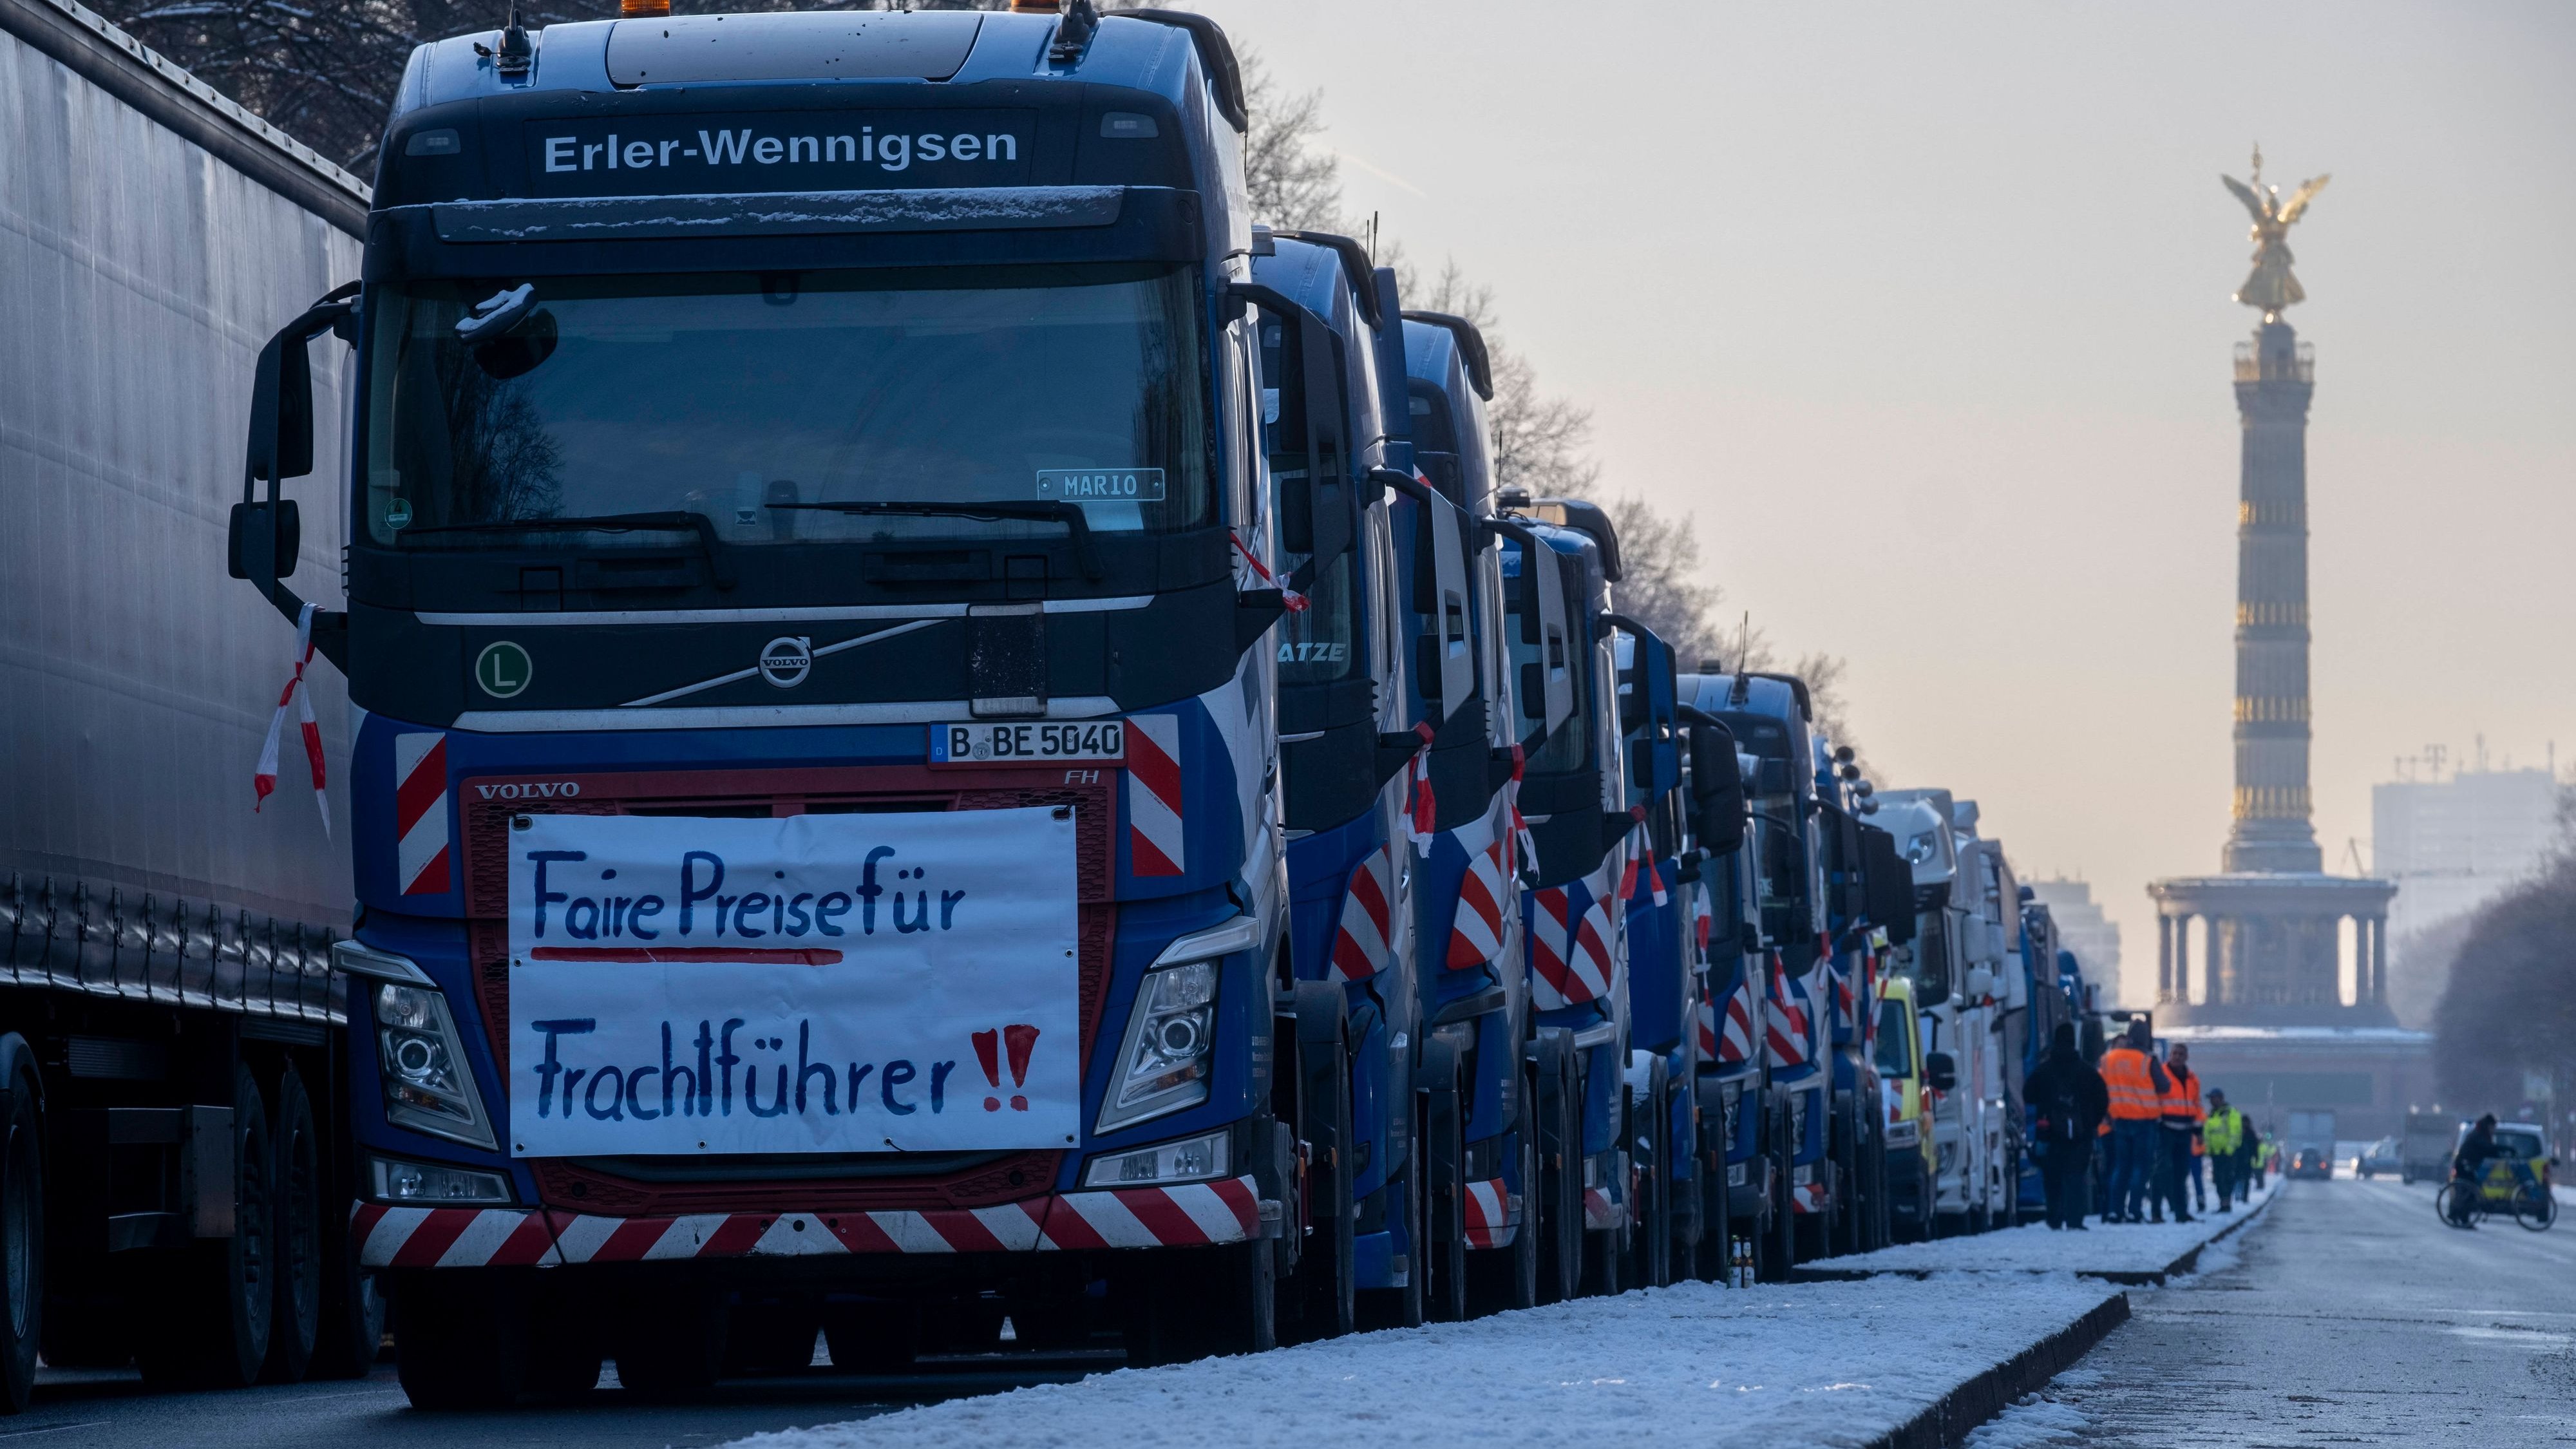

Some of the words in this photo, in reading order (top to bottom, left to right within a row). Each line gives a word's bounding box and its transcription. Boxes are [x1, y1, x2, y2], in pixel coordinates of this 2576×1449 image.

[545, 126, 1017, 171] Erler-Wennigsen
[1065, 475, 1137, 496] MARIO
[494, 654, 516, 687] L
[762, 658, 808, 667] VOLVO
[936, 747, 943, 755] D
[951, 728, 971, 757] B
[993, 726, 1034, 756] BE
[1041, 724, 1120, 755] 5040
[1065, 770, 1099, 784] FH
[475, 782, 580, 799] VOLVO
[527, 851, 665, 940] Faire
